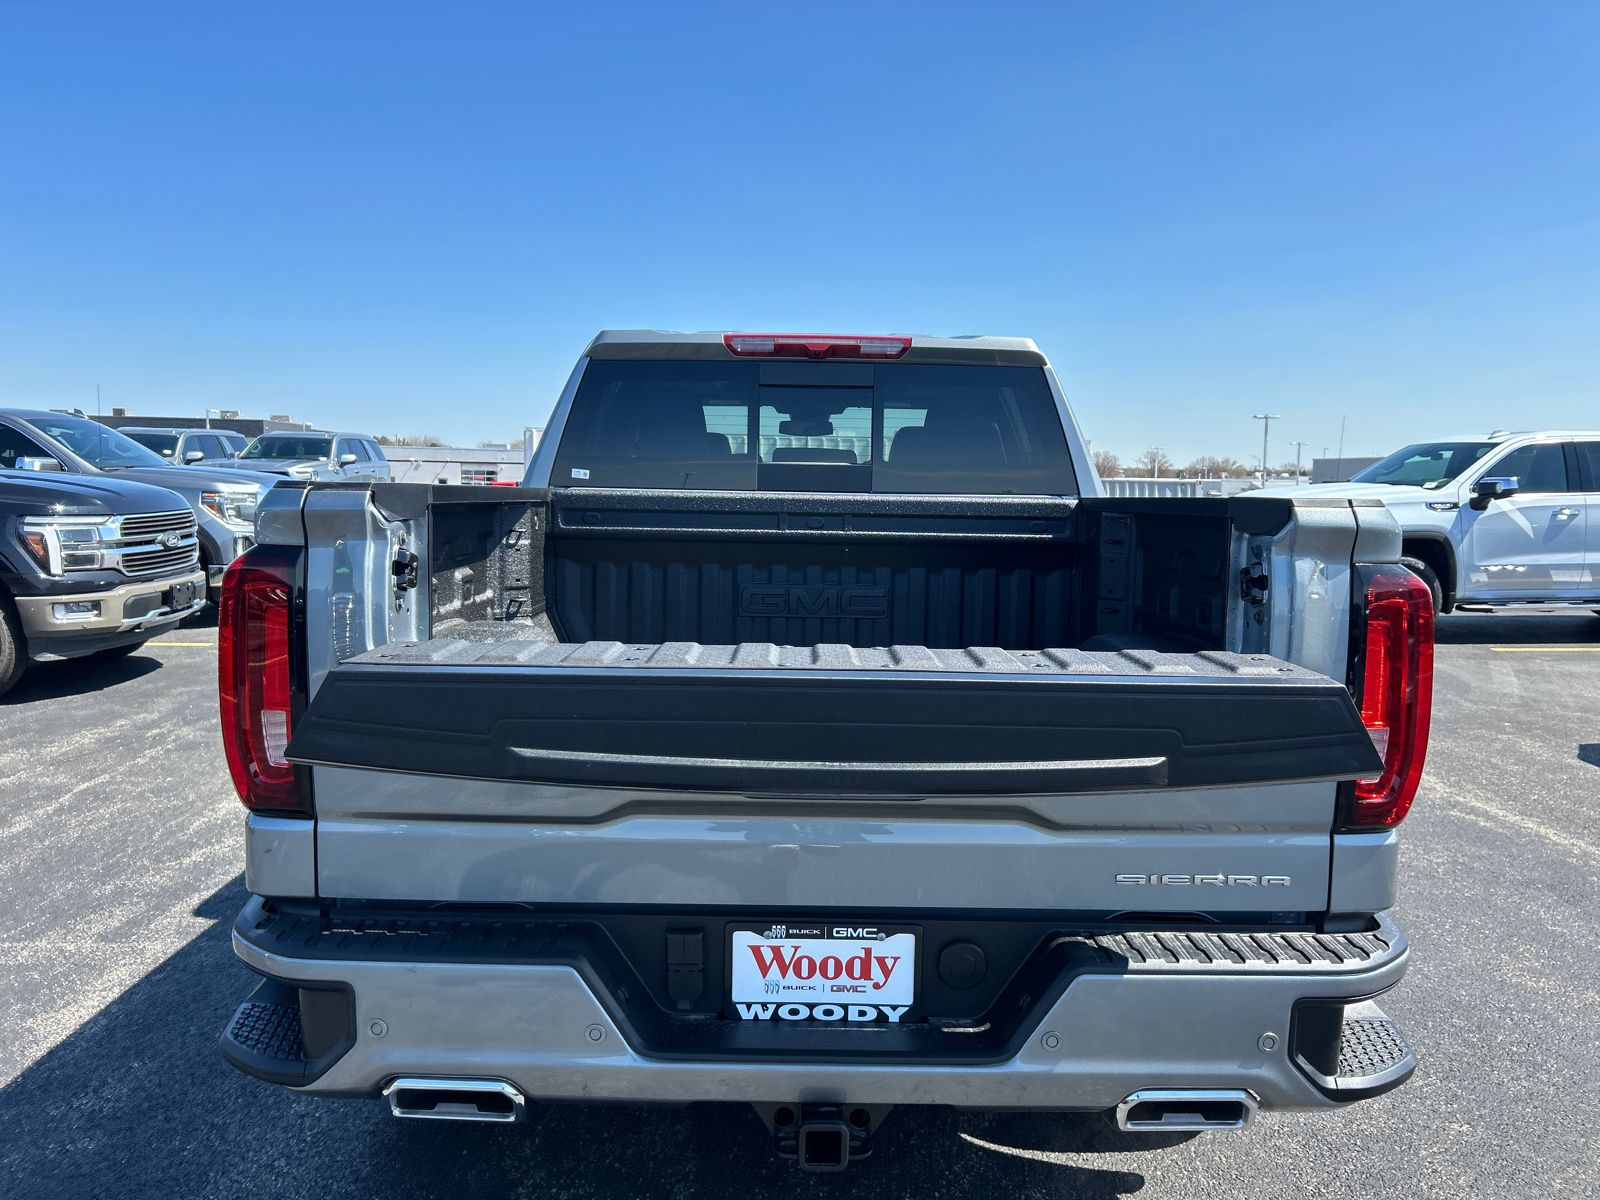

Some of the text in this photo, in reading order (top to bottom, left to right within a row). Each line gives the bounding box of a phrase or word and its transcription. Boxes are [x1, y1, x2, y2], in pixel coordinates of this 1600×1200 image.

[741, 587, 887, 616] GMC
[1114, 874, 1291, 887] SIERRA
[832, 927, 878, 938] GMC
[747, 945, 901, 990] Woody
[830, 984, 867, 993] GMC
[735, 1003, 910, 1023] WOODY
